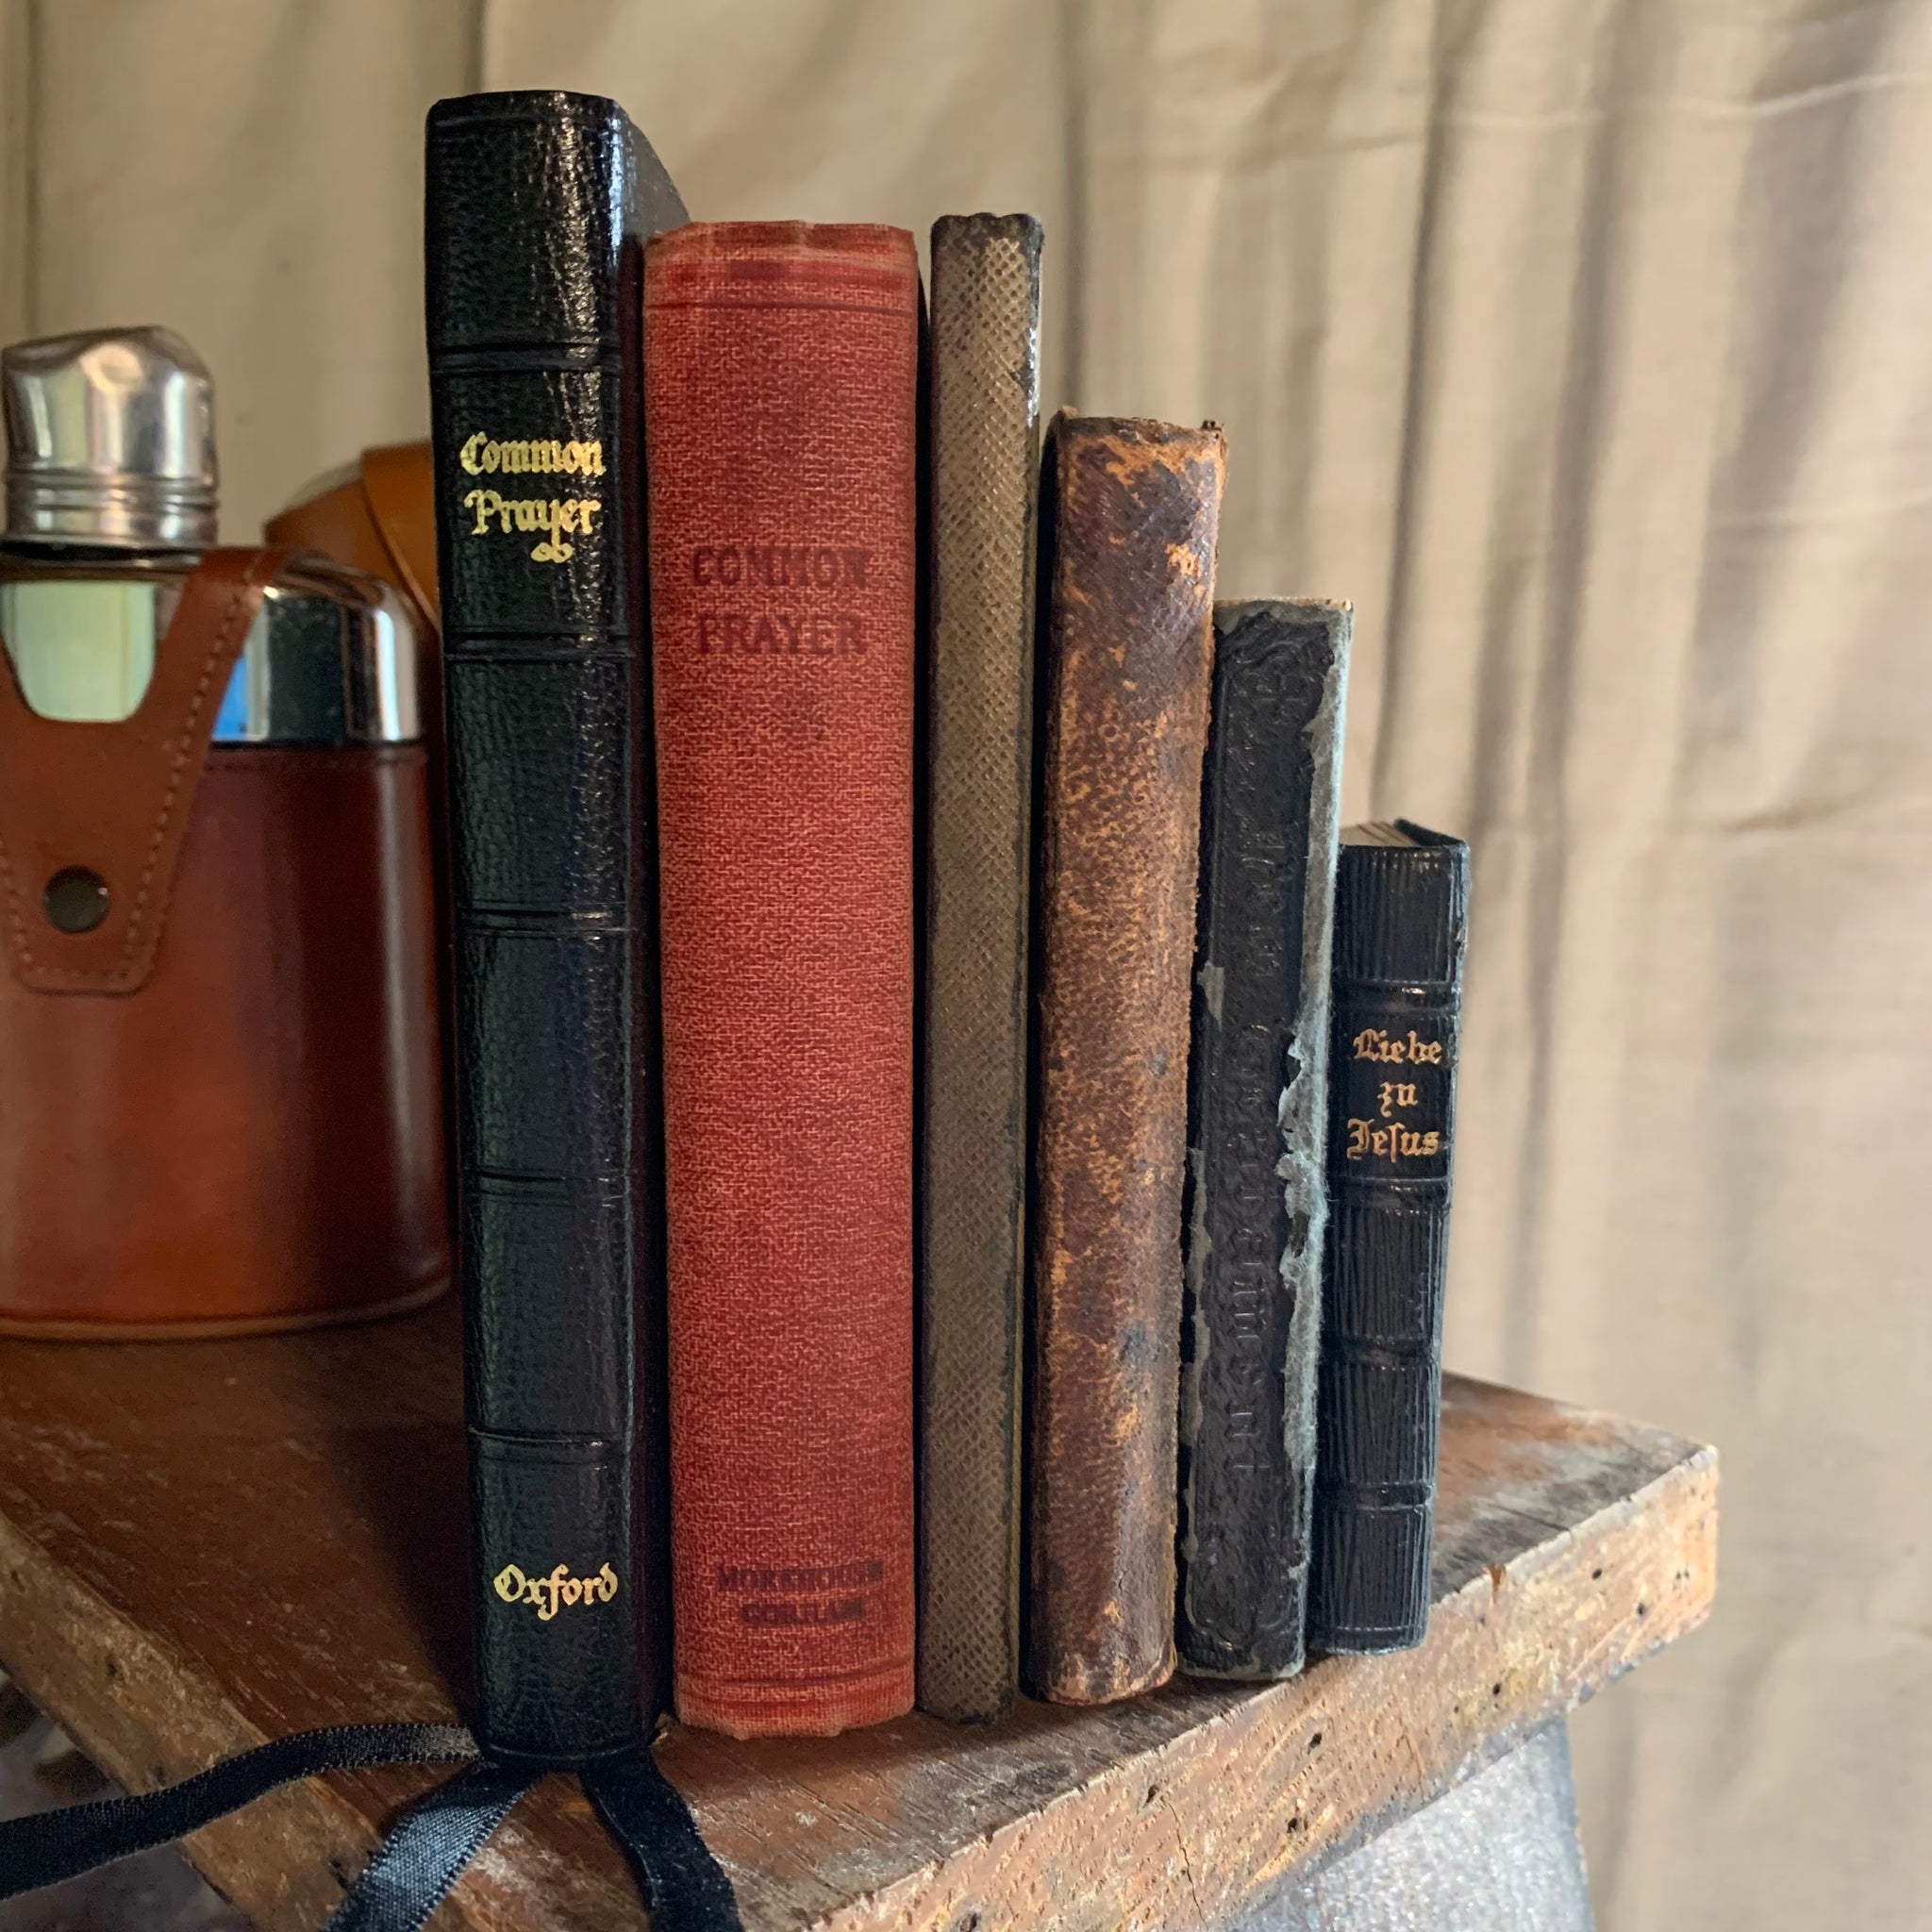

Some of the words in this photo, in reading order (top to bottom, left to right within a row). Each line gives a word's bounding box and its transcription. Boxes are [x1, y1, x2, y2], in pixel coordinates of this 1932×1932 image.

[459, 431, 606, 475] Common
[463, 489, 602, 562] Prayer
[697, 613, 869, 655] PRAYER
[1353, 1028, 1442, 1064] Liebe
[1377, 1081, 1418, 1117] zu
[492, 1562, 618, 1621] Oxford
